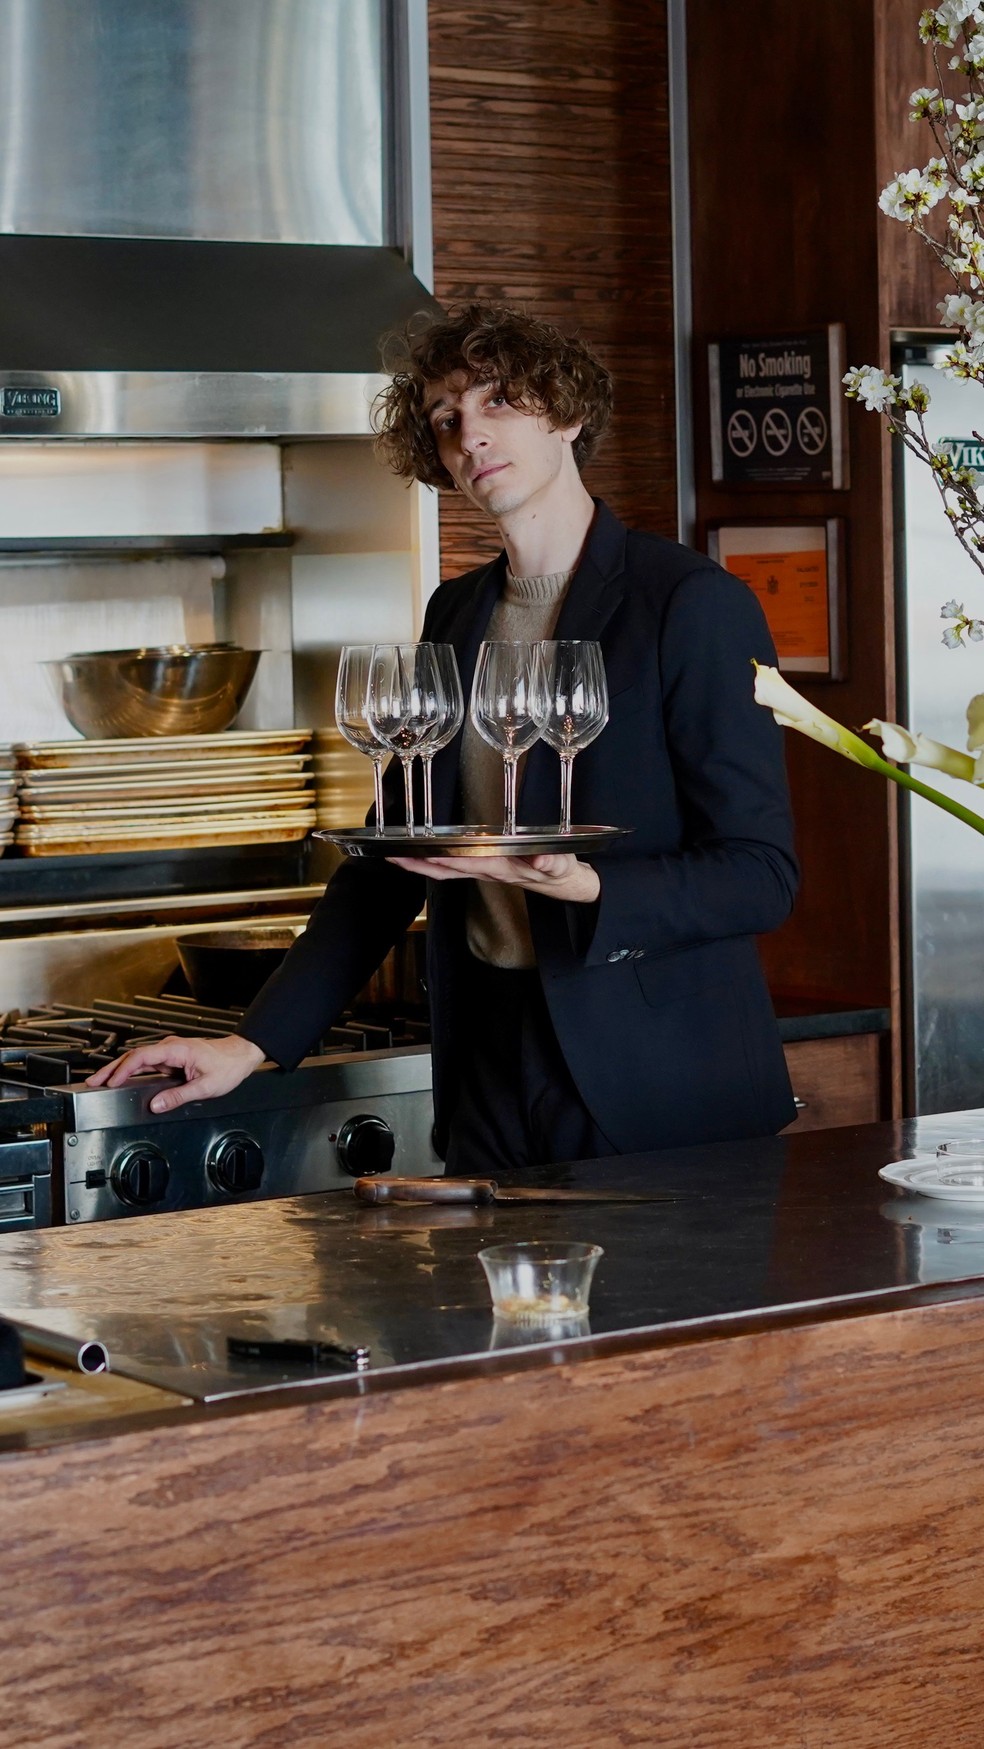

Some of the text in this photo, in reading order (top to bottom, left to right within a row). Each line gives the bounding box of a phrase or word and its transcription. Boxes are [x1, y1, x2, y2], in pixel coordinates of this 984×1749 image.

[739, 350, 811, 378] No Smoking
[775, 383, 802, 399] Cigarette
